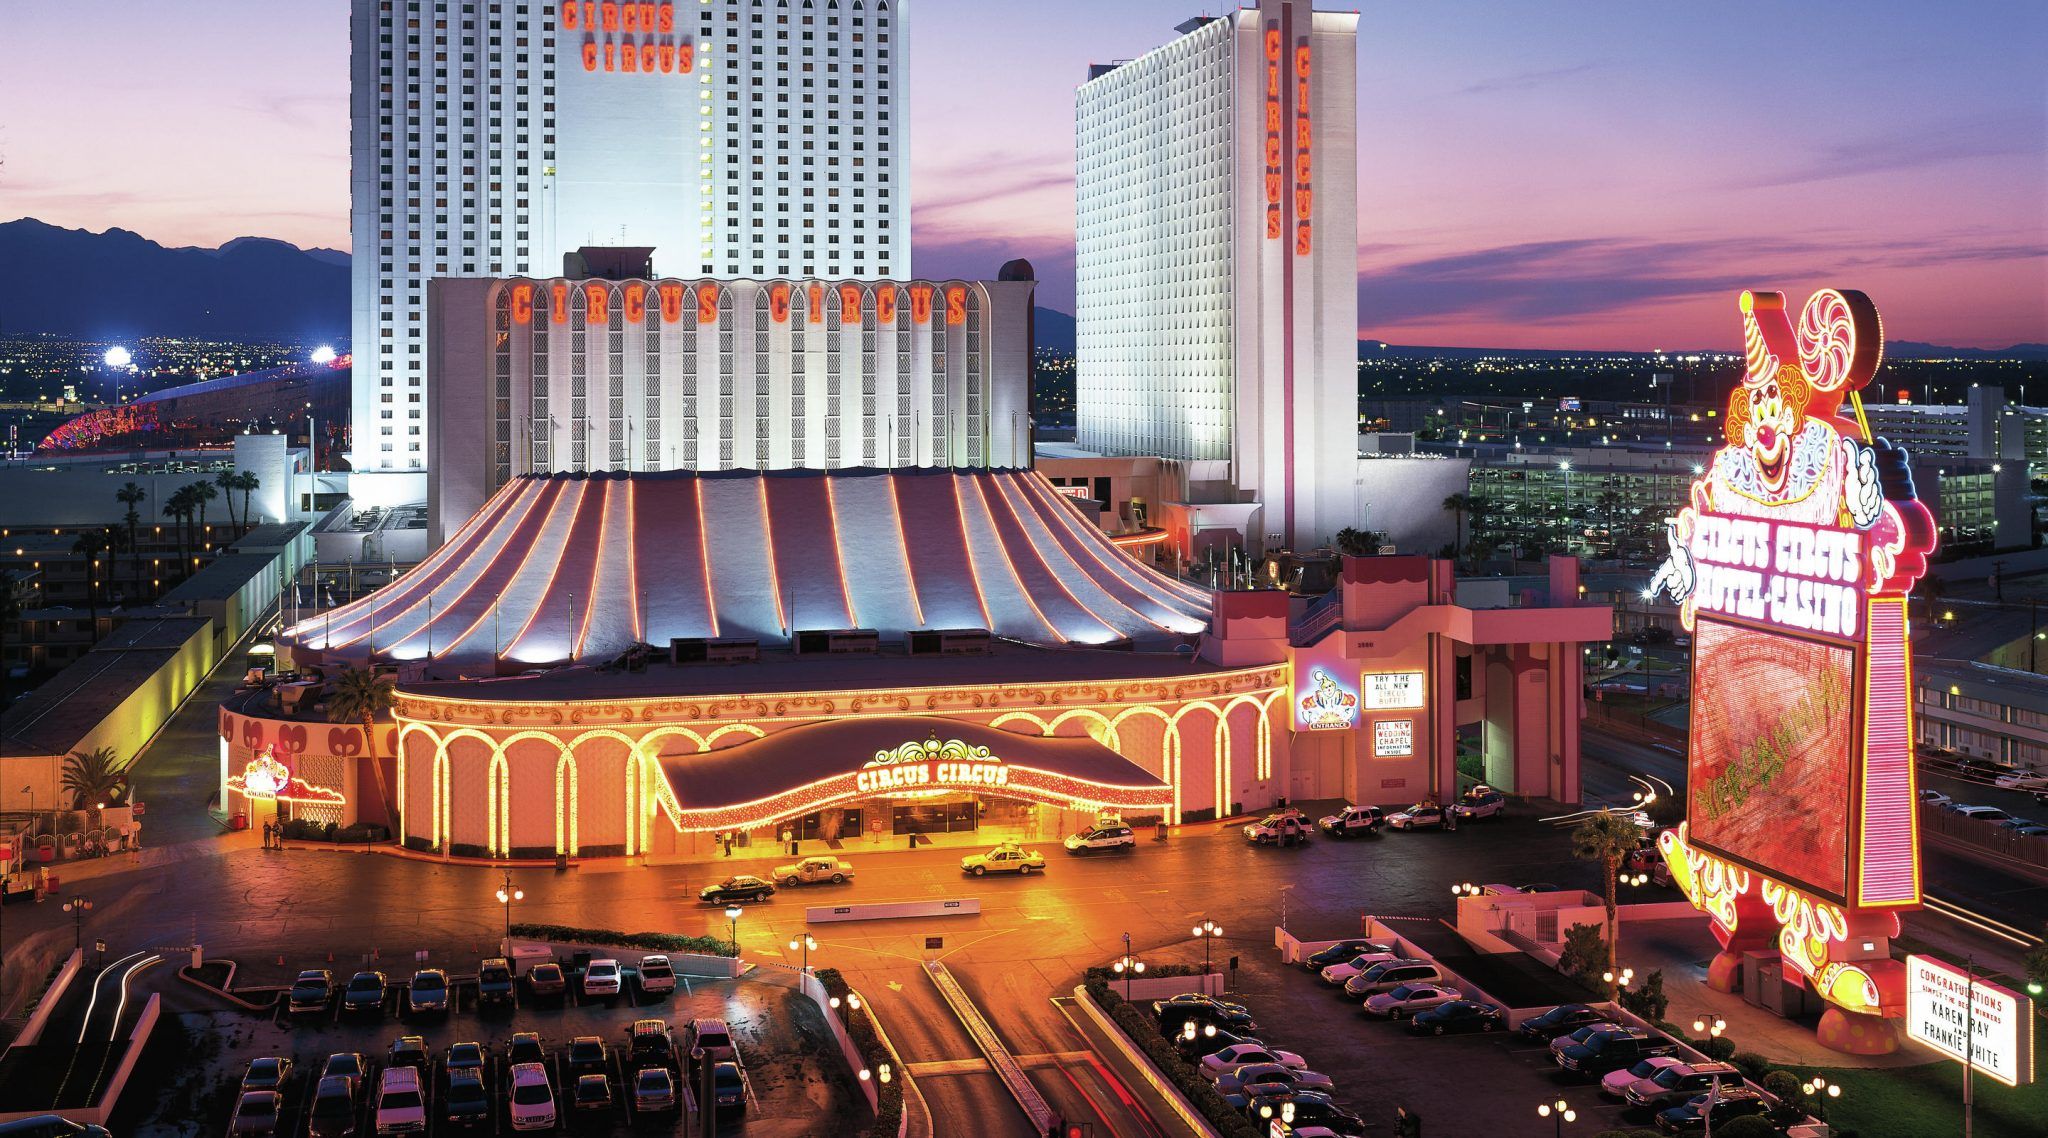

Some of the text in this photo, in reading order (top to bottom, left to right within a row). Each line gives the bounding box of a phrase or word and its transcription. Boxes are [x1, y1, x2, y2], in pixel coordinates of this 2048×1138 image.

[562, 1, 674, 33] CIRCUS
[582, 43, 694, 74] CIRCUS
[1265, 29, 1281, 239] CIRCUS
[1296, 46, 1312, 256] CIRCUS
[512, 285, 967, 325] CIRCUS CIRCUS
[1693, 515, 1863, 583] CIRCUS CIRCUS
[1695, 562, 1857, 637] HOTEL CASINO
[857, 763, 1008, 791] CIRCUS CIRCUS
[1920, 968, 2002, 1012] CONGRATULATIONS
[1932, 1001, 1989, 1038] KAREN RAY
[1954, 1028, 1967, 1038] AND
[1975, 1008, 2001, 1024] WINNERS
[1924, 1021, 1962, 1051] FRANKIE
